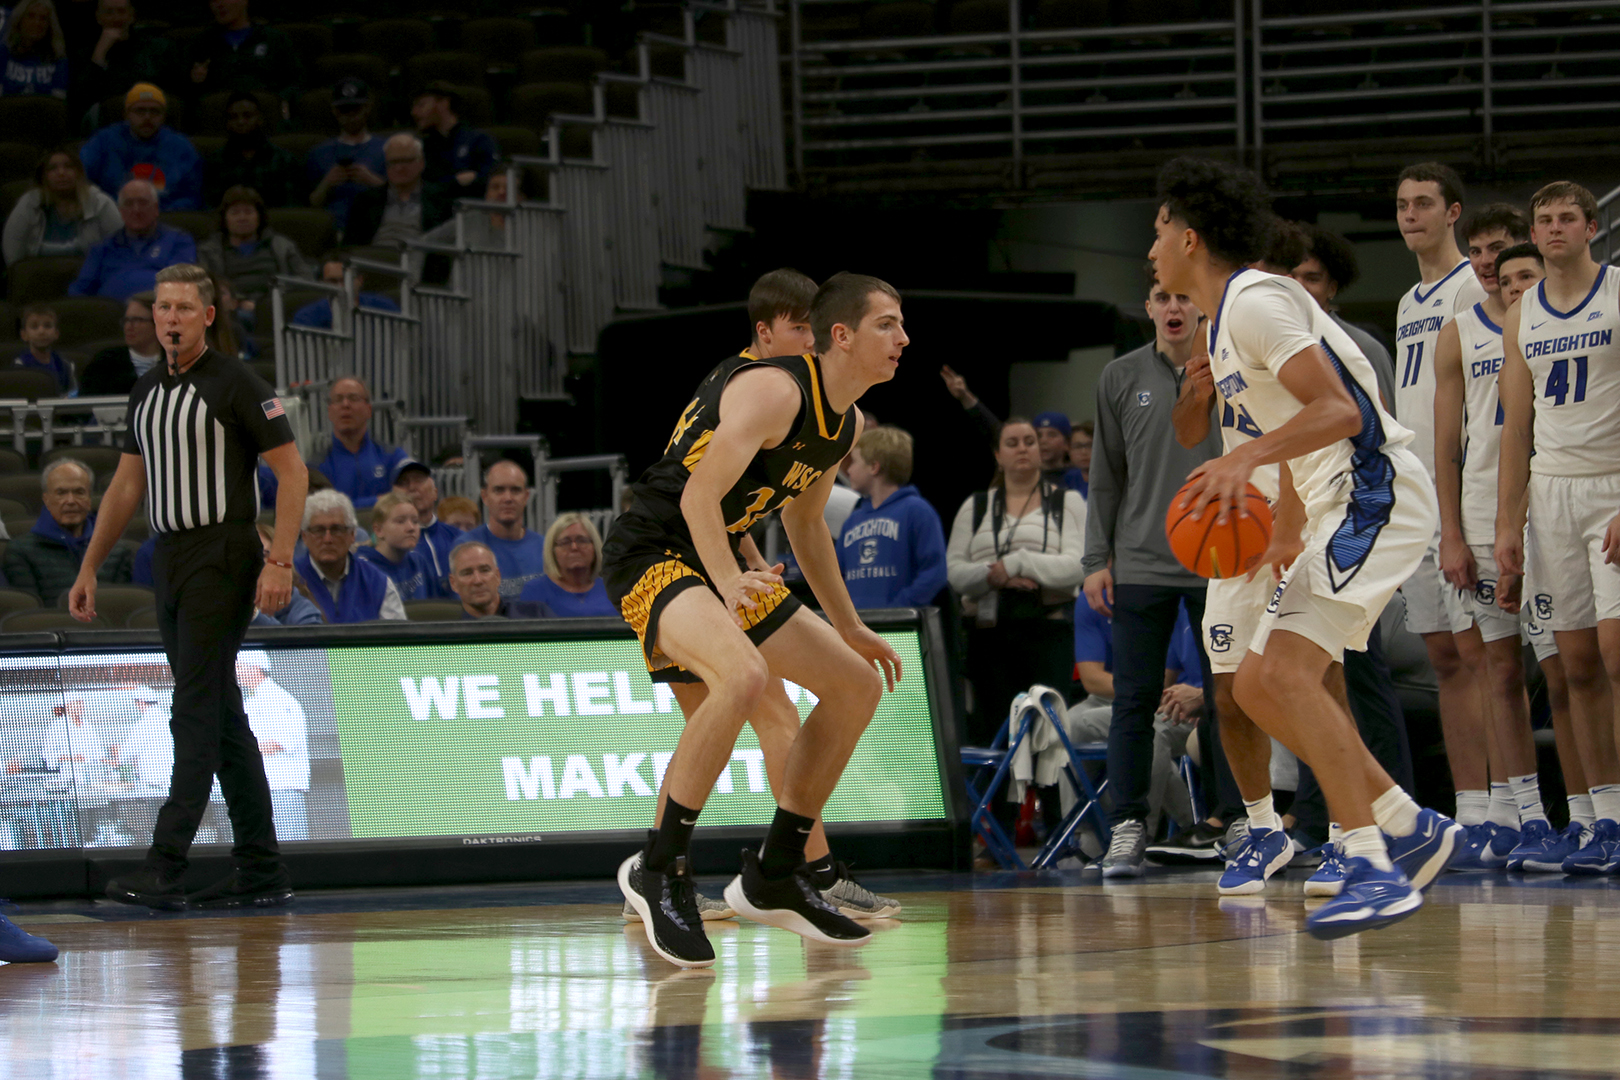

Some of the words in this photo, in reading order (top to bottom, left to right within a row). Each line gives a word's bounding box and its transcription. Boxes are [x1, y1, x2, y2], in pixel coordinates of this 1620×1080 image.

[1397, 316, 1444, 342] CREIGHTON
[1525, 328, 1612, 360] CREIGHTON
[1401, 341, 1424, 389] 11
[1471, 357, 1506, 379] CRE
[1544, 355, 1588, 407] 41
[843, 517, 900, 548] CREIGHTON
[845, 566, 898, 581] ASKETBALL
[400, 675, 506, 721] WE
[462, 835, 542, 846] DAKTRONICS
